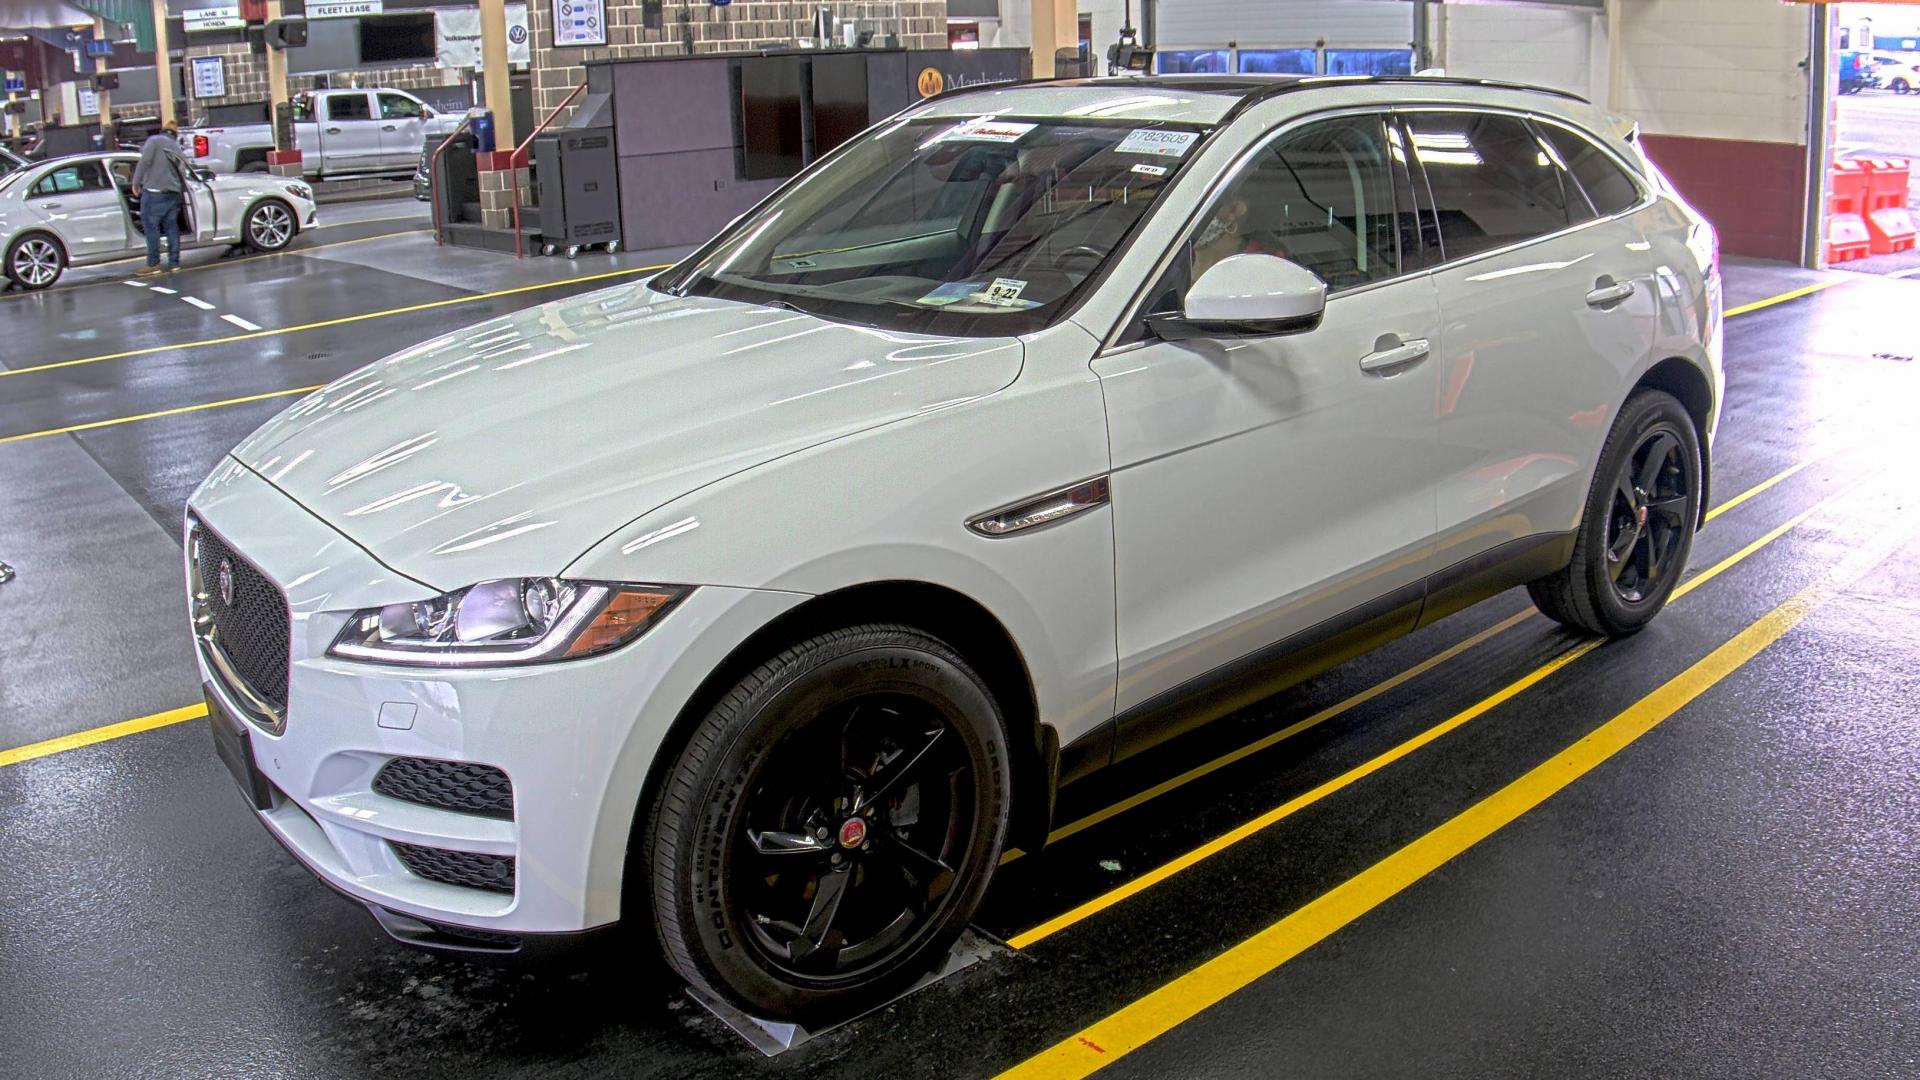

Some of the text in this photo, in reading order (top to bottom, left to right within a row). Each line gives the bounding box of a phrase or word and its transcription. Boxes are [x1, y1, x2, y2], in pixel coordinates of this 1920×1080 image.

[199, 10, 217, 18] LANE
[318, 4, 371, 15] FLEET LEASE
[991, 286, 1018, 299] 9 22
[888, 658, 910, 670] LX
